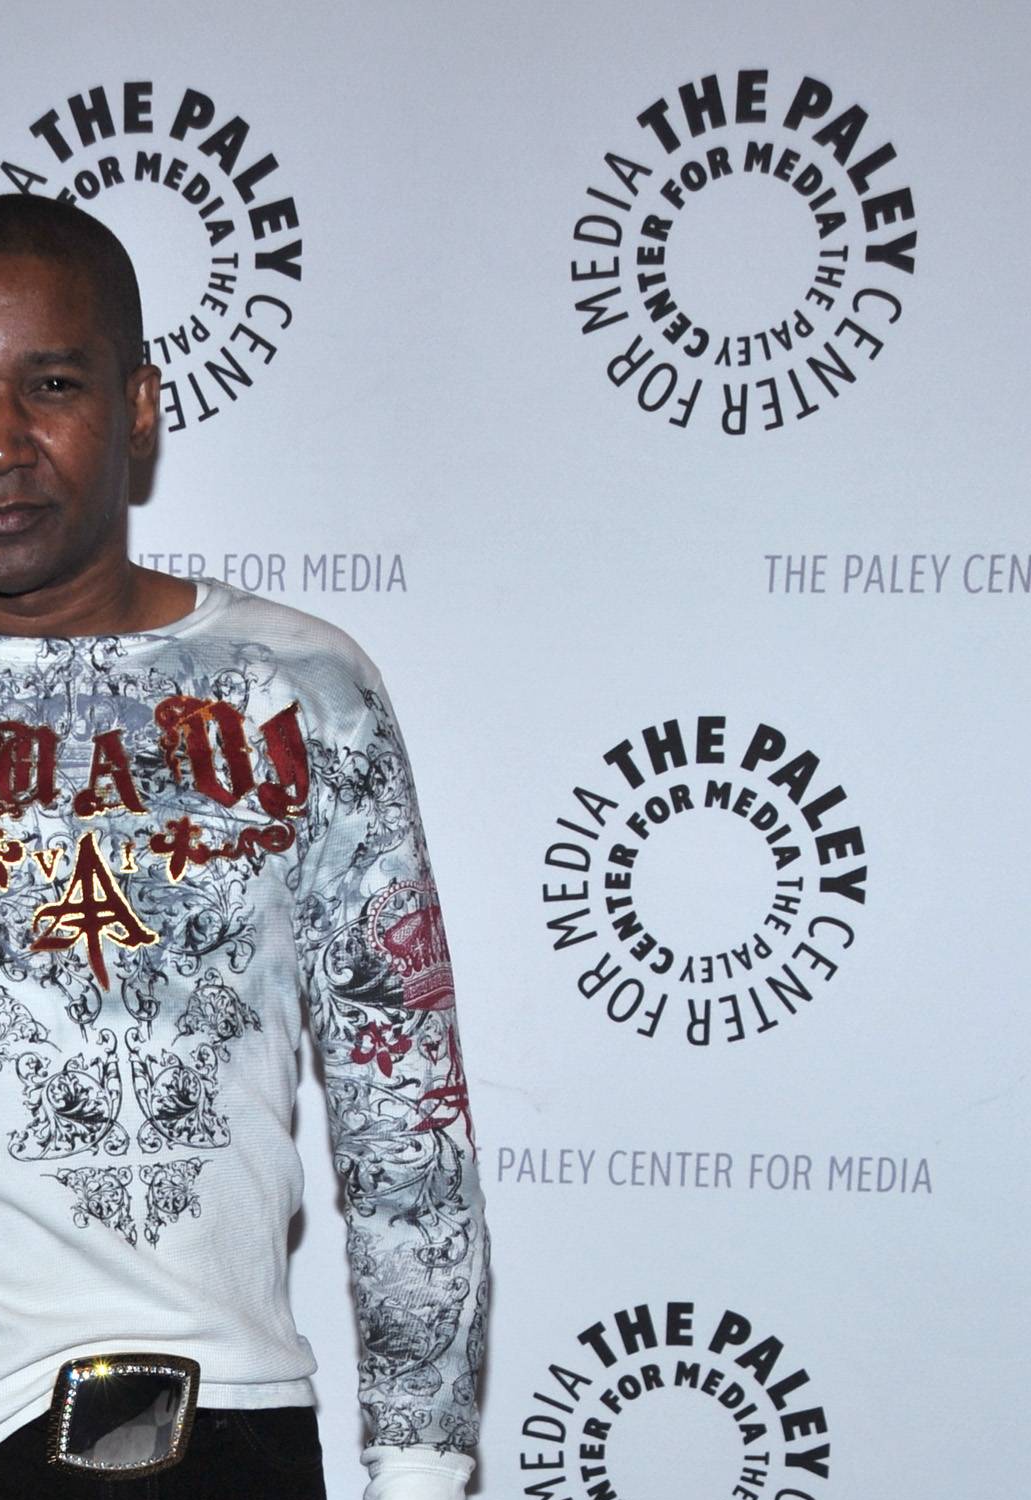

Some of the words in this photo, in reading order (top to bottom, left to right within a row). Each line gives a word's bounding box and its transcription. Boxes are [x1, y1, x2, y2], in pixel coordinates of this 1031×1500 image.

[29, 81, 153, 163] THE
[636, 69, 768, 154] THE
[135, 151, 235, 247] MEDIA
[169, 88, 302, 281] PALEY
[660, 146, 733, 210] FOR
[744, 141, 846, 239] MEDIA
[783, 76, 917, 274] PALEY
[200, 253, 238, 316] THE
[571, 152, 653, 334] MEDIA
[637, 214, 709, 358] CENTER
[805, 245, 848, 311] THE
[160, 295, 292, 432] CENTE
[607, 334, 702, 428] FOR
[714, 309, 814, 367] PALEY
[722, 288, 902, 435] CENTER
[224, 553, 286, 592] FOR
[303, 554, 407, 592] MEDIA
[764, 554, 827, 594] THE
[843, 554, 951, 594] PALEY
[963, 554, 1031, 594] CEN
[603, 716, 726, 789] THE
[626, 784, 694, 840] FOR
[704, 780, 801, 870] MEDIA
[740, 723, 867, 904] PALEY
[543, 787, 619, 951] MEDIA
[605, 844, 674, 974] CENTER
[764, 877, 803, 935] THE
[578, 952, 668, 1038] FOR
[679, 933, 772, 983] PALEY
[687, 916, 854, 1046] CENTER
[497, 1147, 596, 1184] PALEY
[608, 1150, 733, 1188] CENTER
[749, 1154, 812, 1190] FOR
[828, 1156, 932, 1194] MEDIA
[577, 1302, 694, 1368] THE
[708, 1310, 830, 1479] PALEY
[600, 1364, 664, 1415] FOR
[674, 1361, 767, 1445] MEDIA
